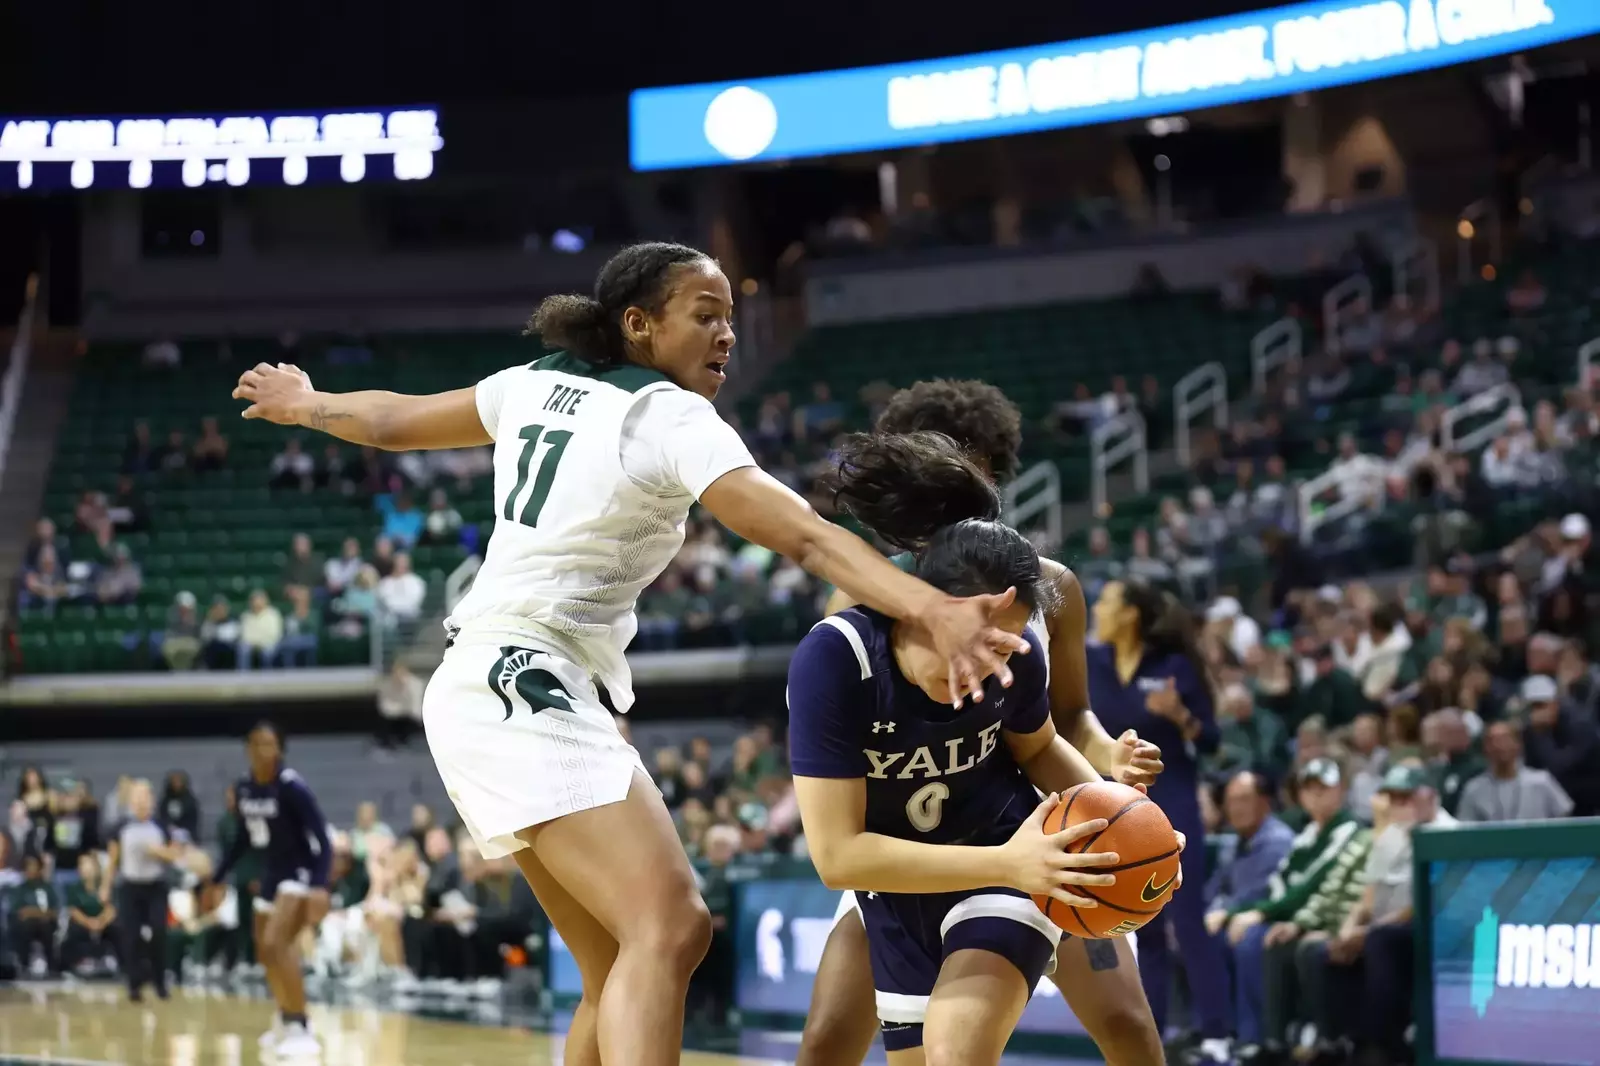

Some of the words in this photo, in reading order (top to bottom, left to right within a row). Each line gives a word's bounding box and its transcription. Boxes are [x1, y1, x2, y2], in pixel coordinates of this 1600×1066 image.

[542, 384, 590, 415] TATE
[504, 424, 574, 528] 11
[862, 719, 1002, 779] YALE
[905, 782, 949, 832] 0
